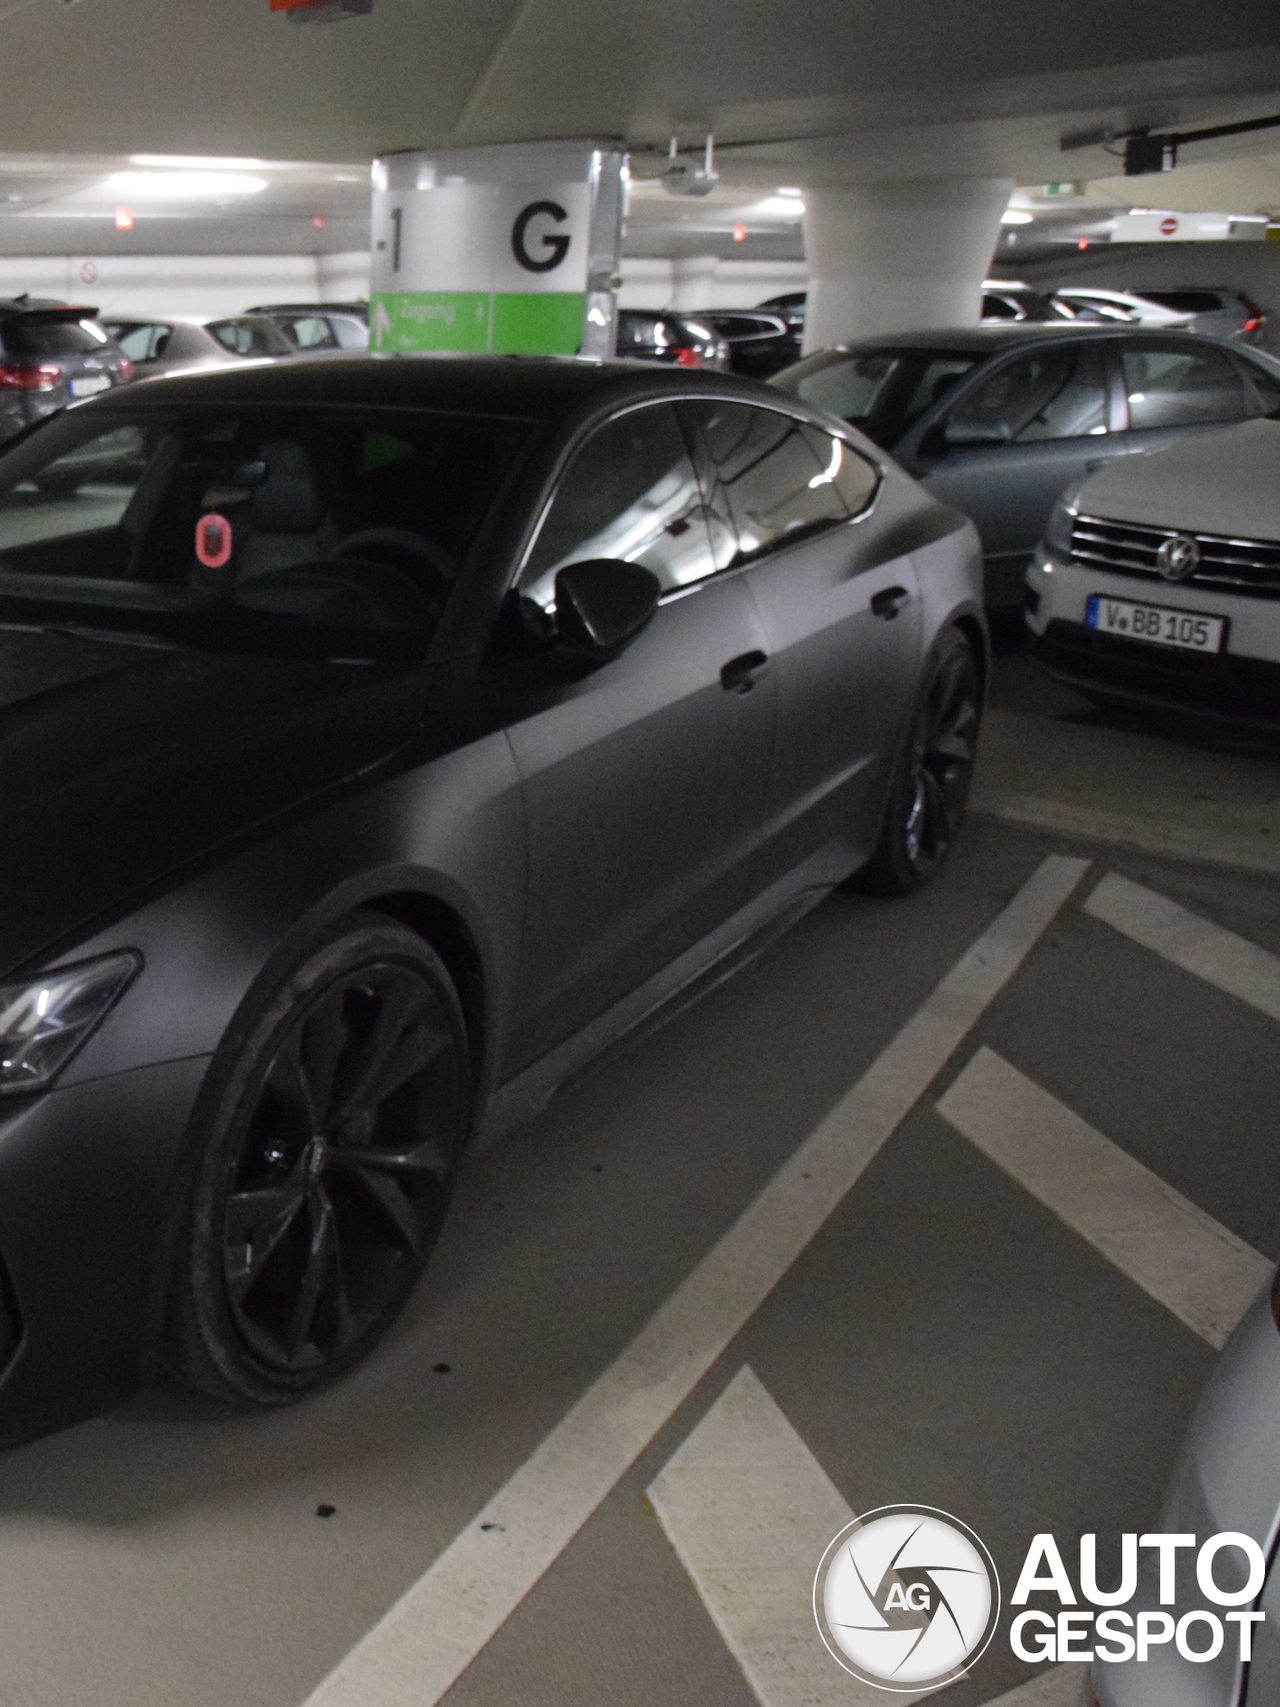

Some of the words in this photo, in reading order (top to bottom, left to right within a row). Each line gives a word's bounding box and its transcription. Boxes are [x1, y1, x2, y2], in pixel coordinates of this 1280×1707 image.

[377, 208, 403, 273] -1
[511, 201, 572, 274] G
[1106, 604, 1121, 628] V
[1131, 609, 1161, 636] BB
[1165, 616, 1209, 646] 105
